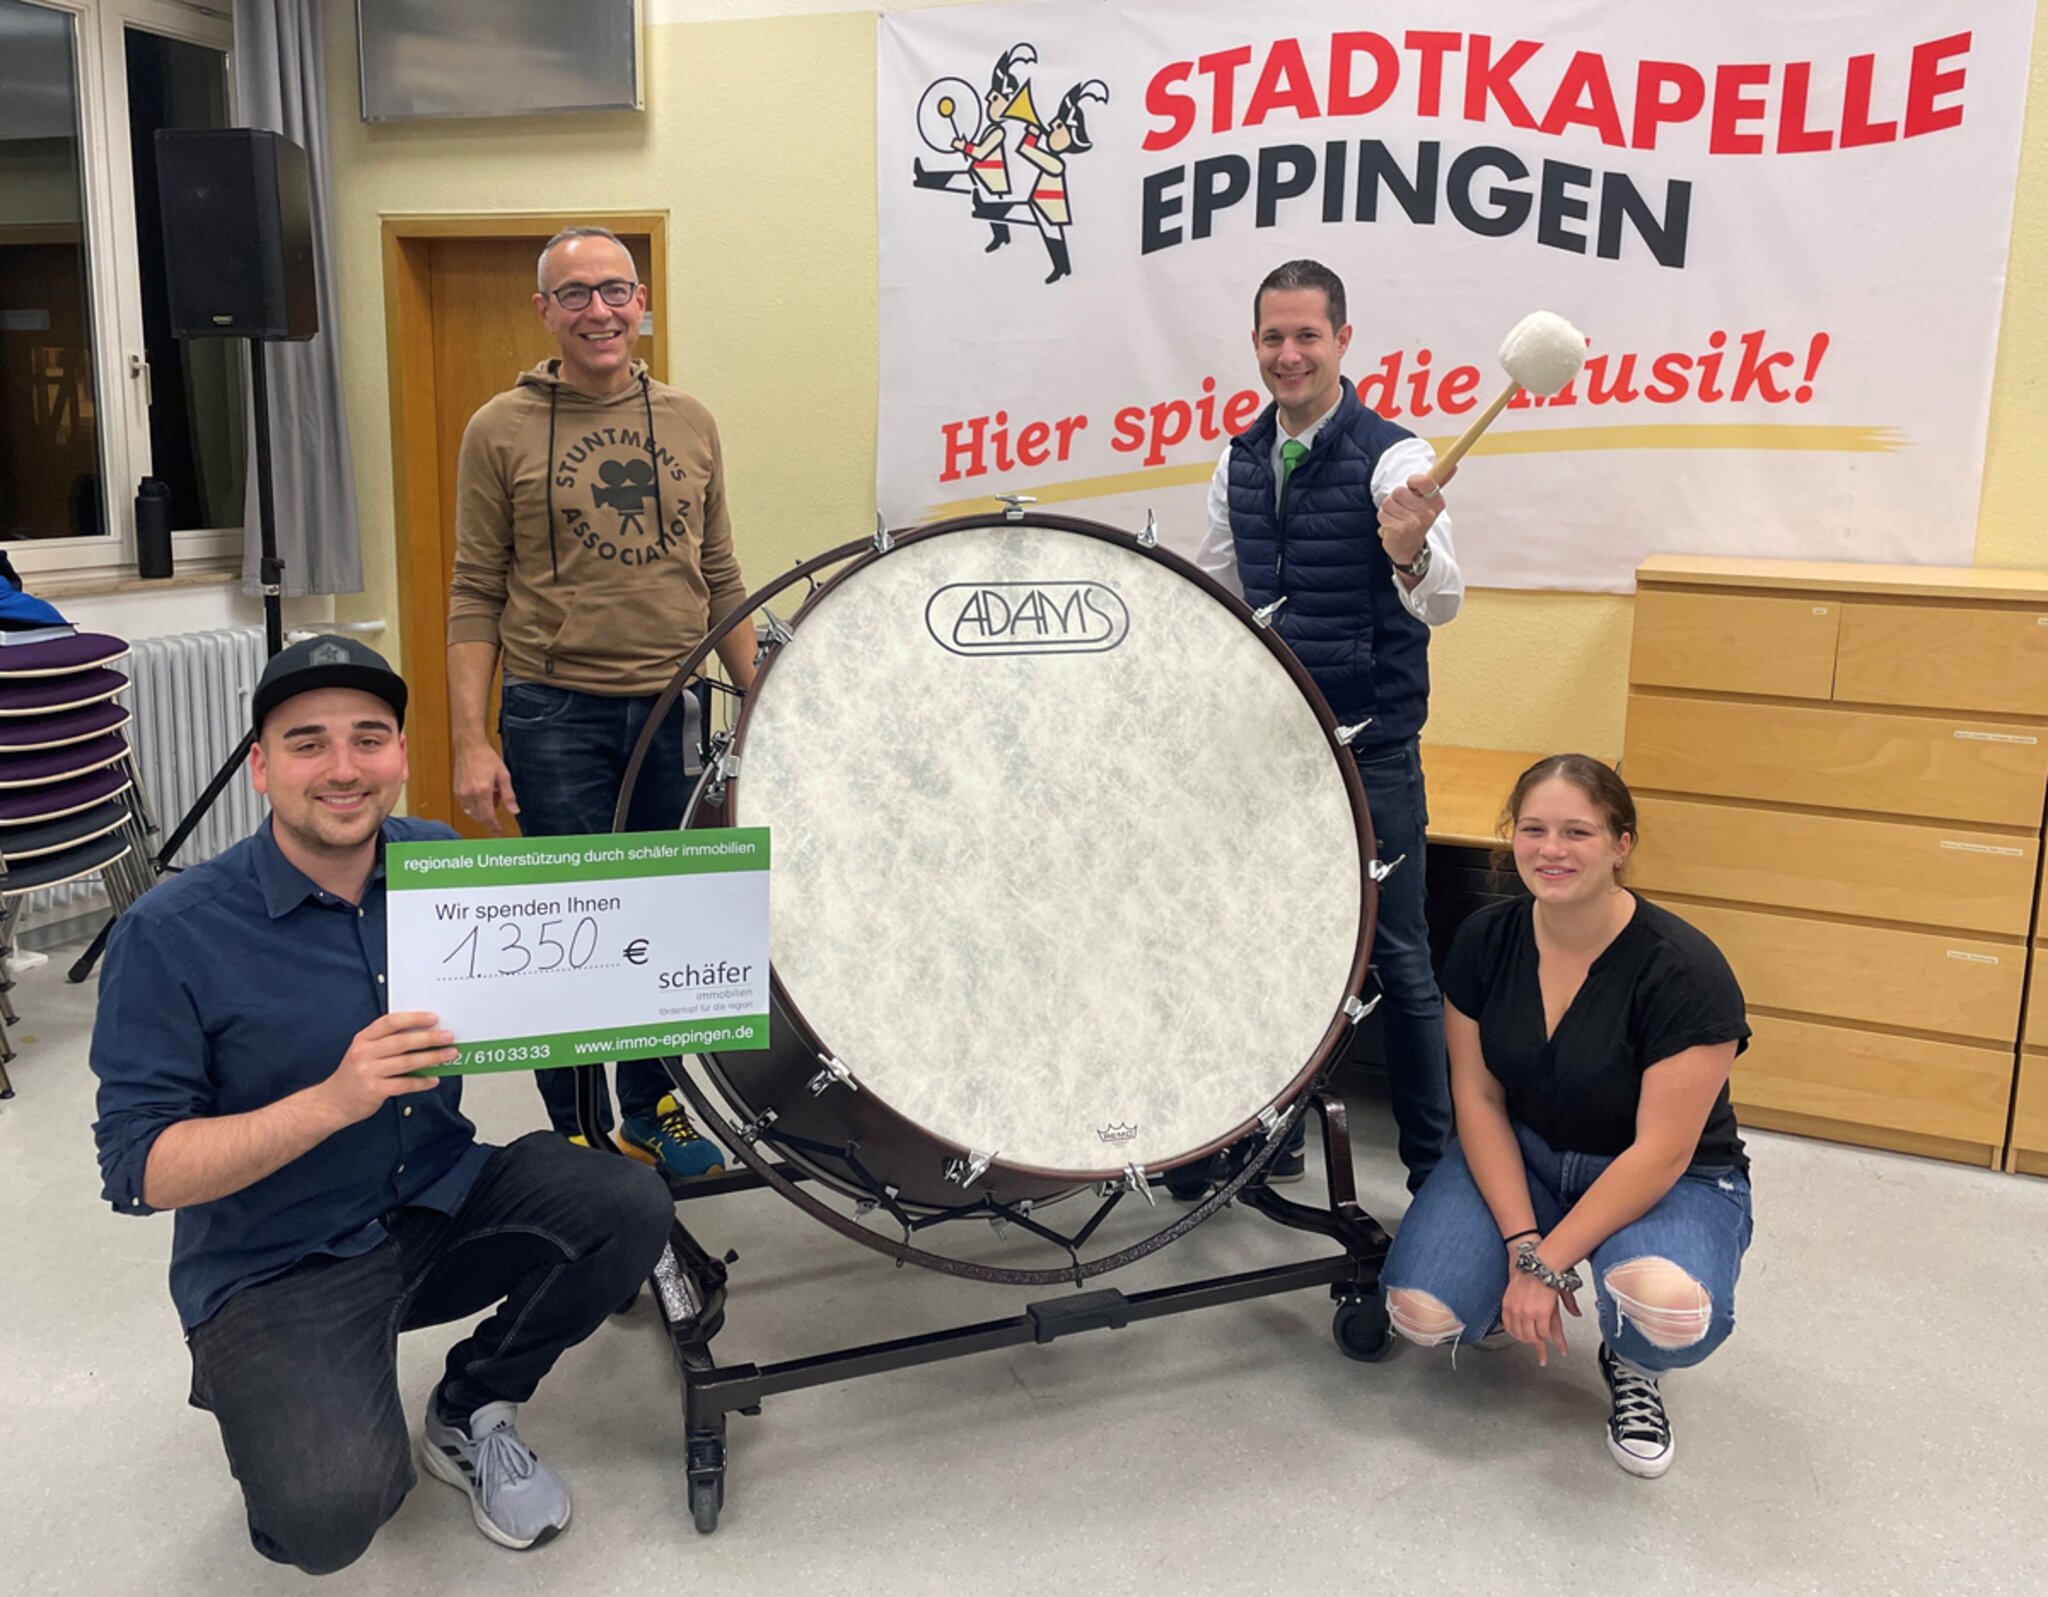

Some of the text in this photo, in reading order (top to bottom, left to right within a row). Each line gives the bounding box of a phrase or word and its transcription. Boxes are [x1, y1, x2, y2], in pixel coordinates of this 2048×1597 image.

[1142, 30, 1972, 155] STADTKAPELLE
[1141, 139, 1692, 269] EPPINGEN
[939, 329, 1831, 482] Hier spie die usik!
[556, 428, 687, 488] STUNTMEN'S
[561, 499, 691, 566] ASSOCIATION
[953, 587, 1114, 647] ADAMS
[403, 841, 756, 873] regionale Unterstützung durch schäfer immobilien
[435, 896, 621, 923] Wir spenden Ihnen
[622, 938, 650, 965] €
[658, 961, 752, 989] schäfer
[696, 988, 753, 1001] immobilien
[574, 1025, 754, 1055] www.immo-eppingen.de
